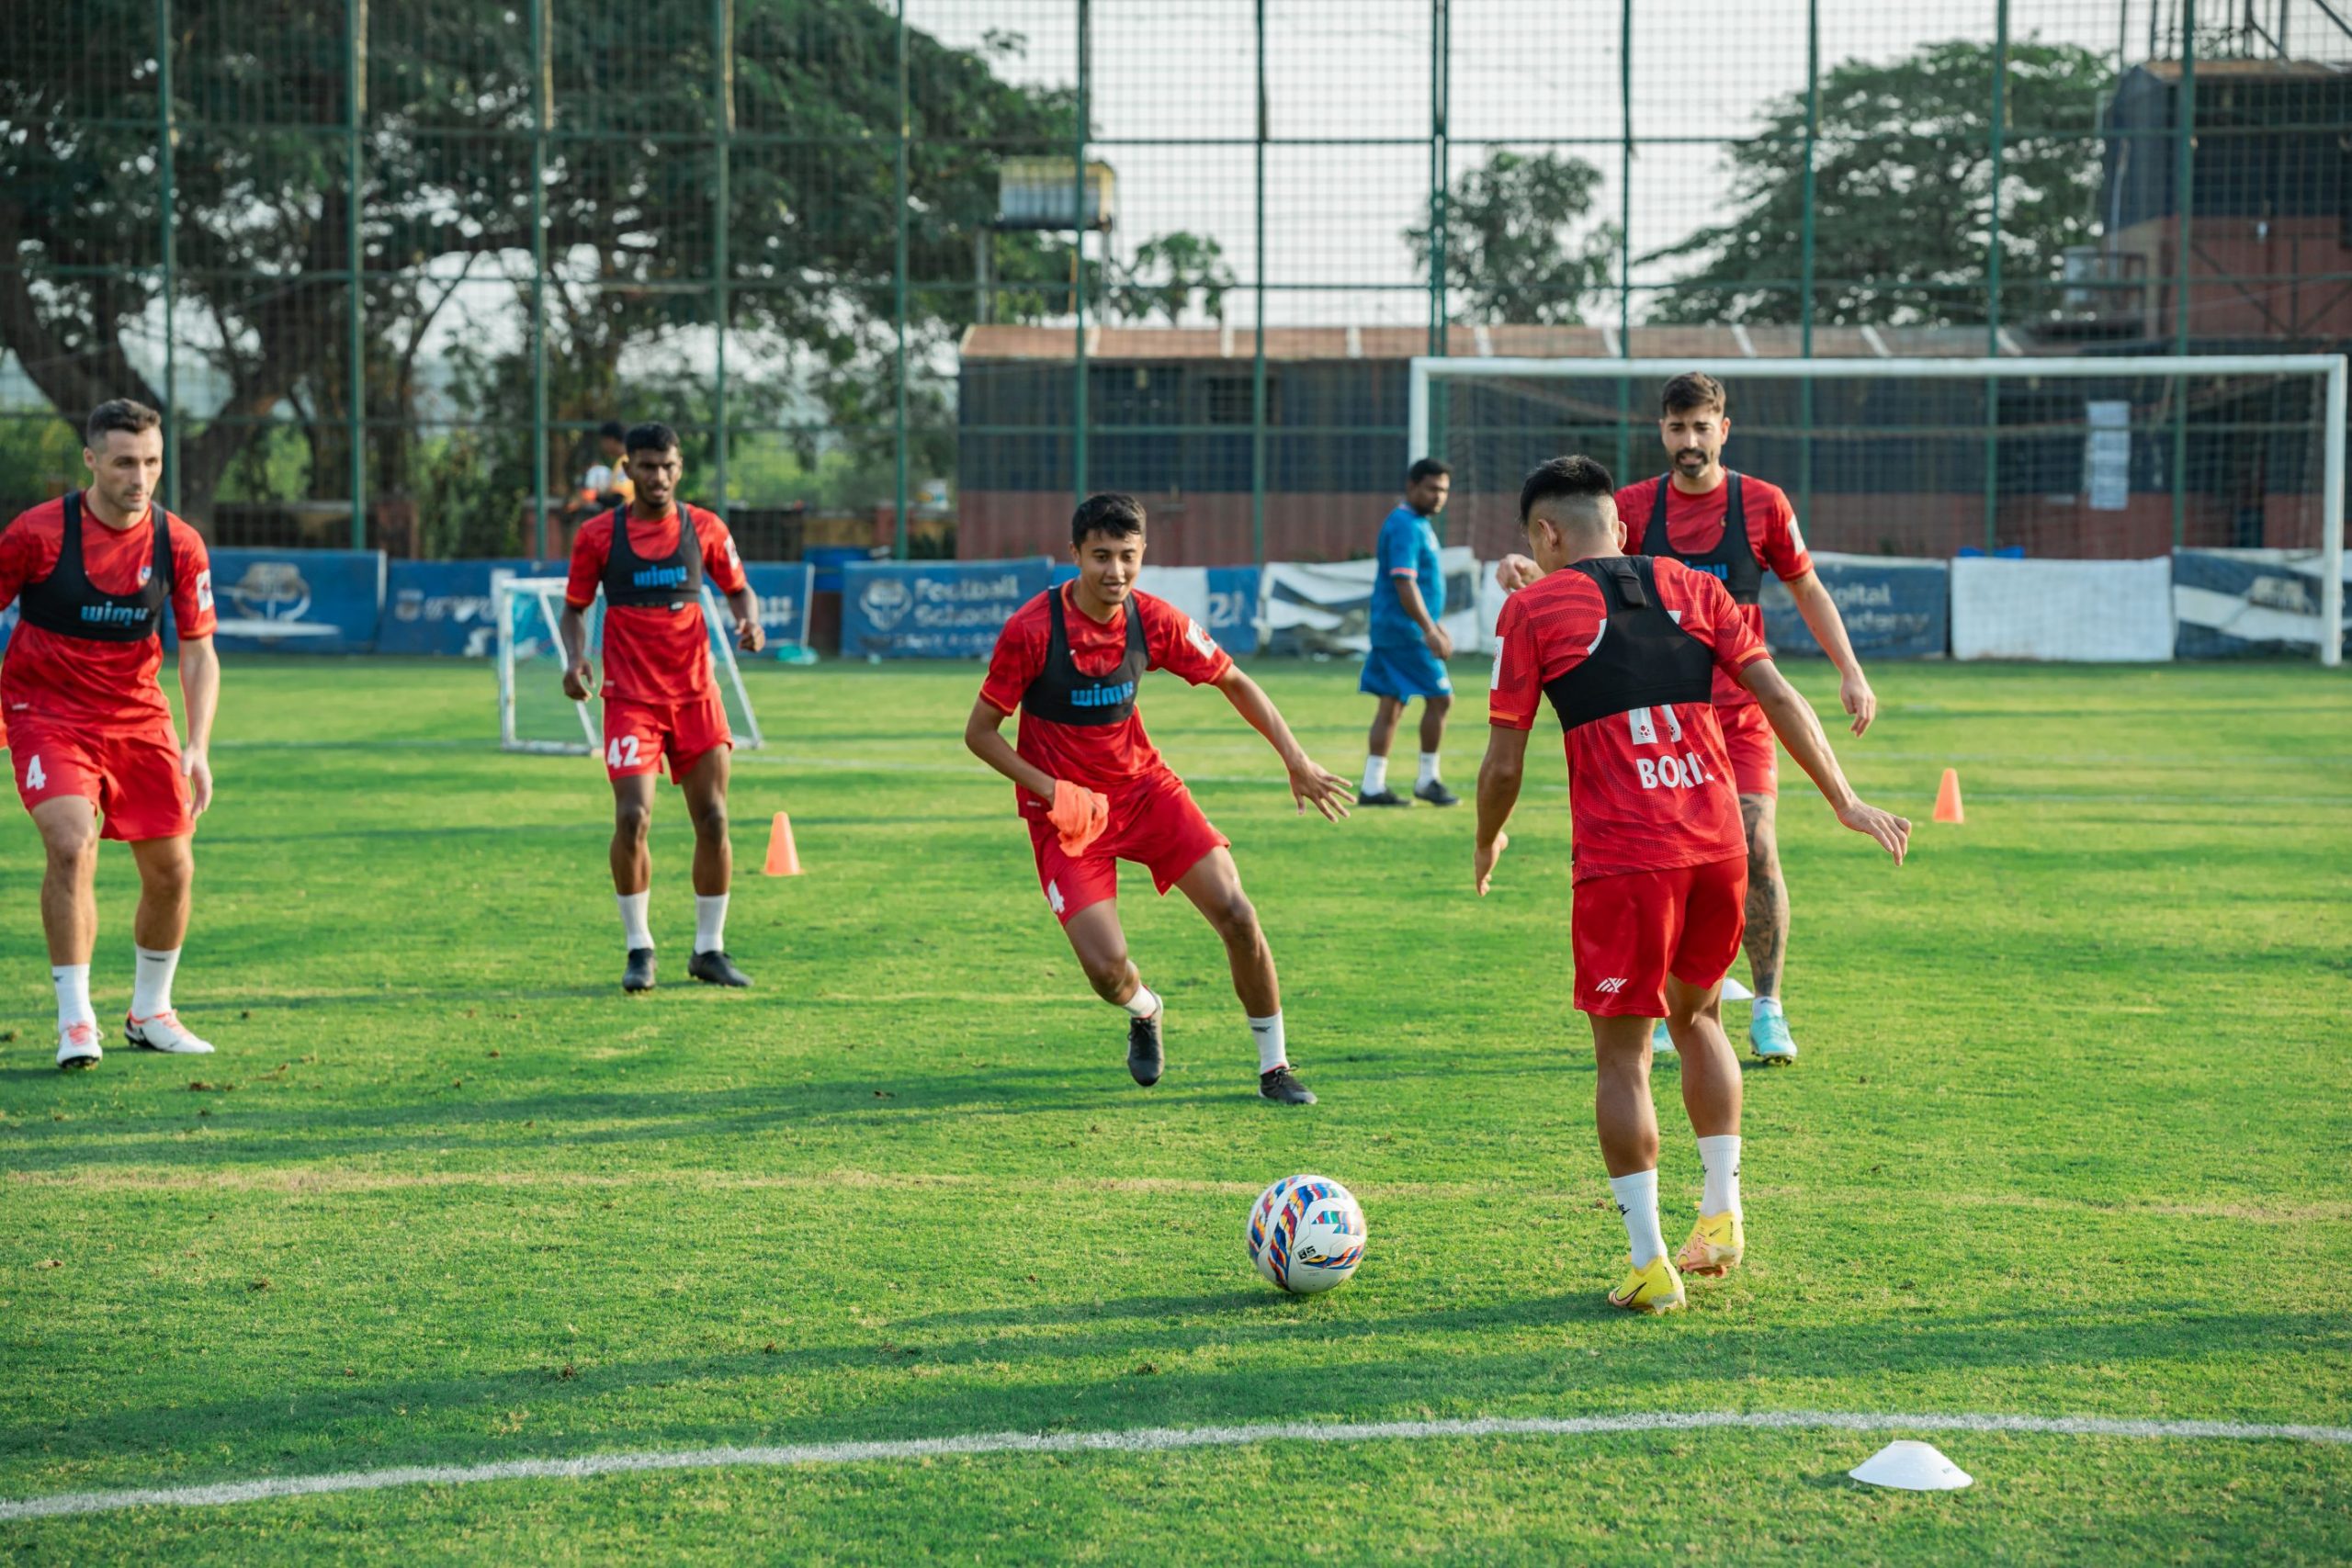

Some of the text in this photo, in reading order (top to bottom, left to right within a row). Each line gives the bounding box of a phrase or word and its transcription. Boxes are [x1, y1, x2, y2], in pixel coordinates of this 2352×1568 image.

[81, 600, 150, 627] wimu
[607, 735, 641, 769] 42
[26, 754, 47, 790] 4
